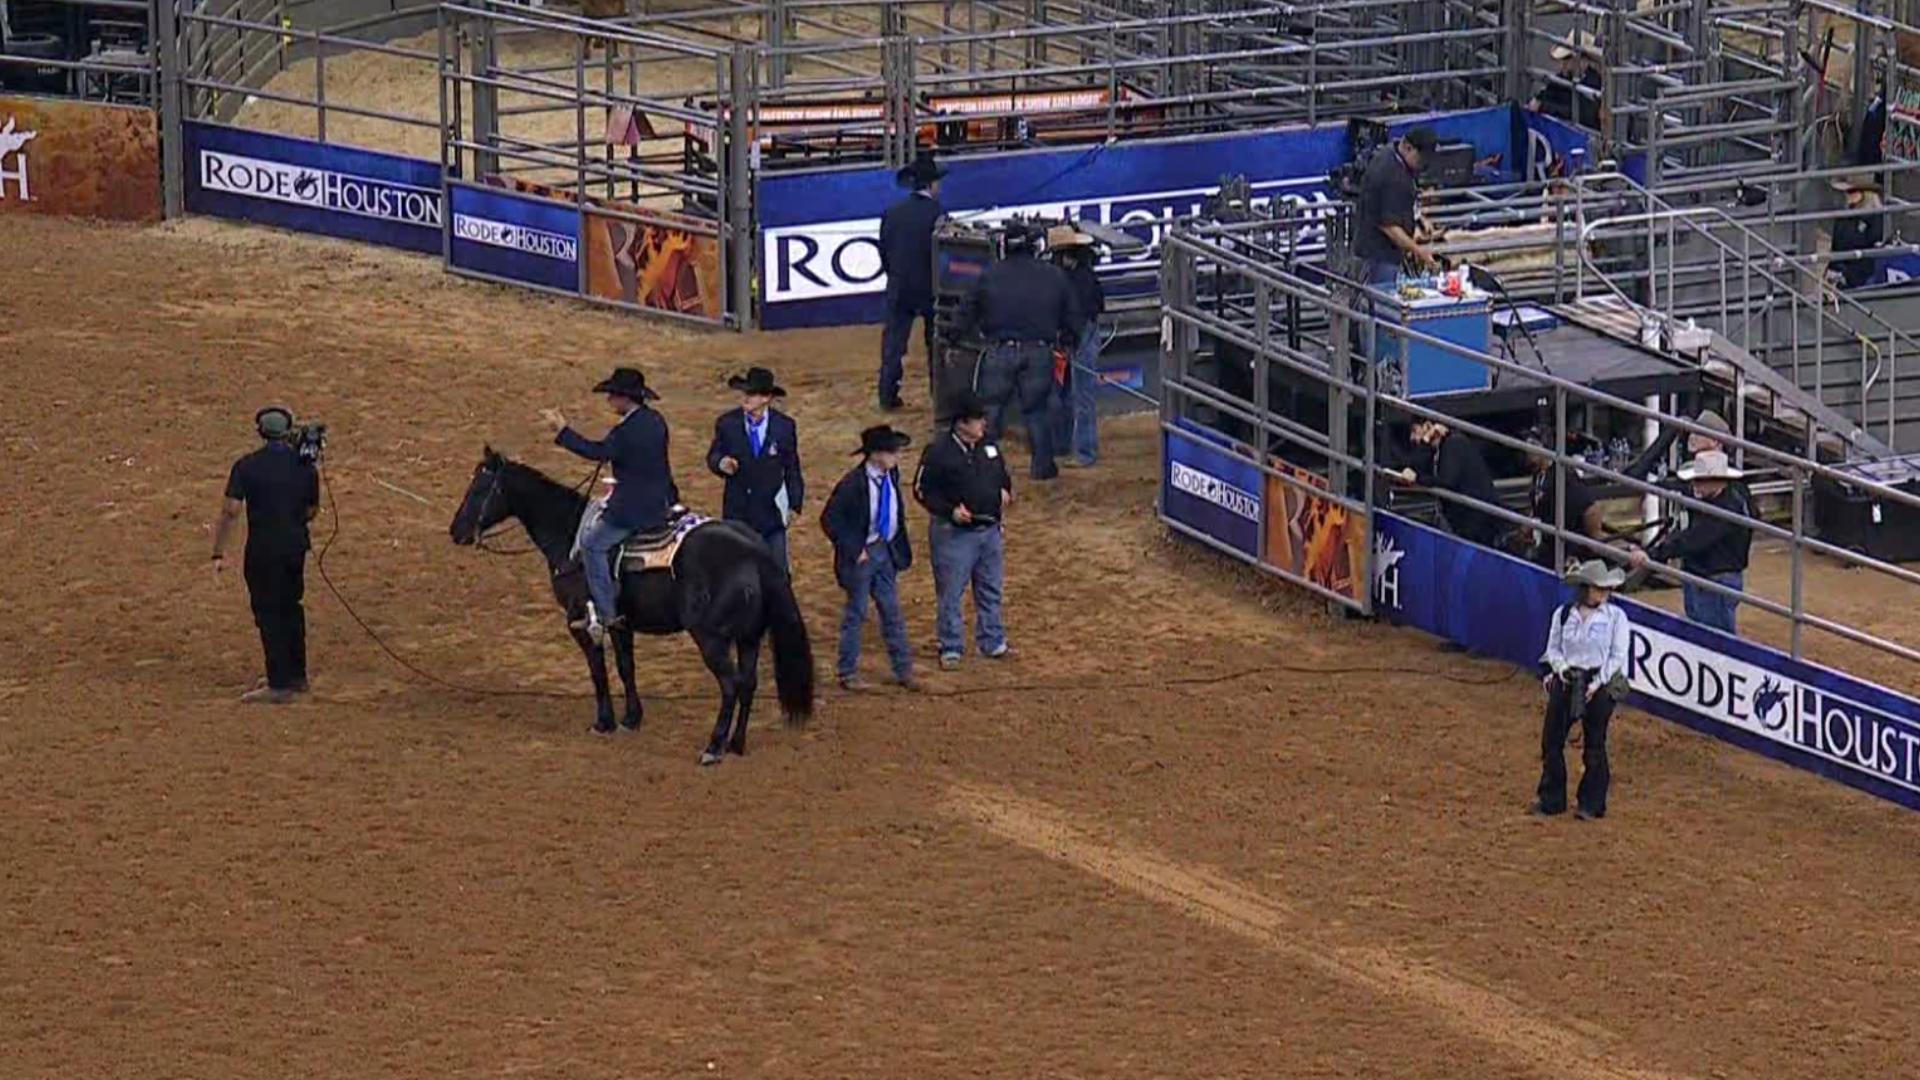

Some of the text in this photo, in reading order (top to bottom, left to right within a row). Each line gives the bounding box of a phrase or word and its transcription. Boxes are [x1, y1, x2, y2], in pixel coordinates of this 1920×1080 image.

[324, 172, 441, 224] HOUSTON
[517, 227, 576, 261] HOUSTON
[1797, 686, 1920, 783] HOUST
